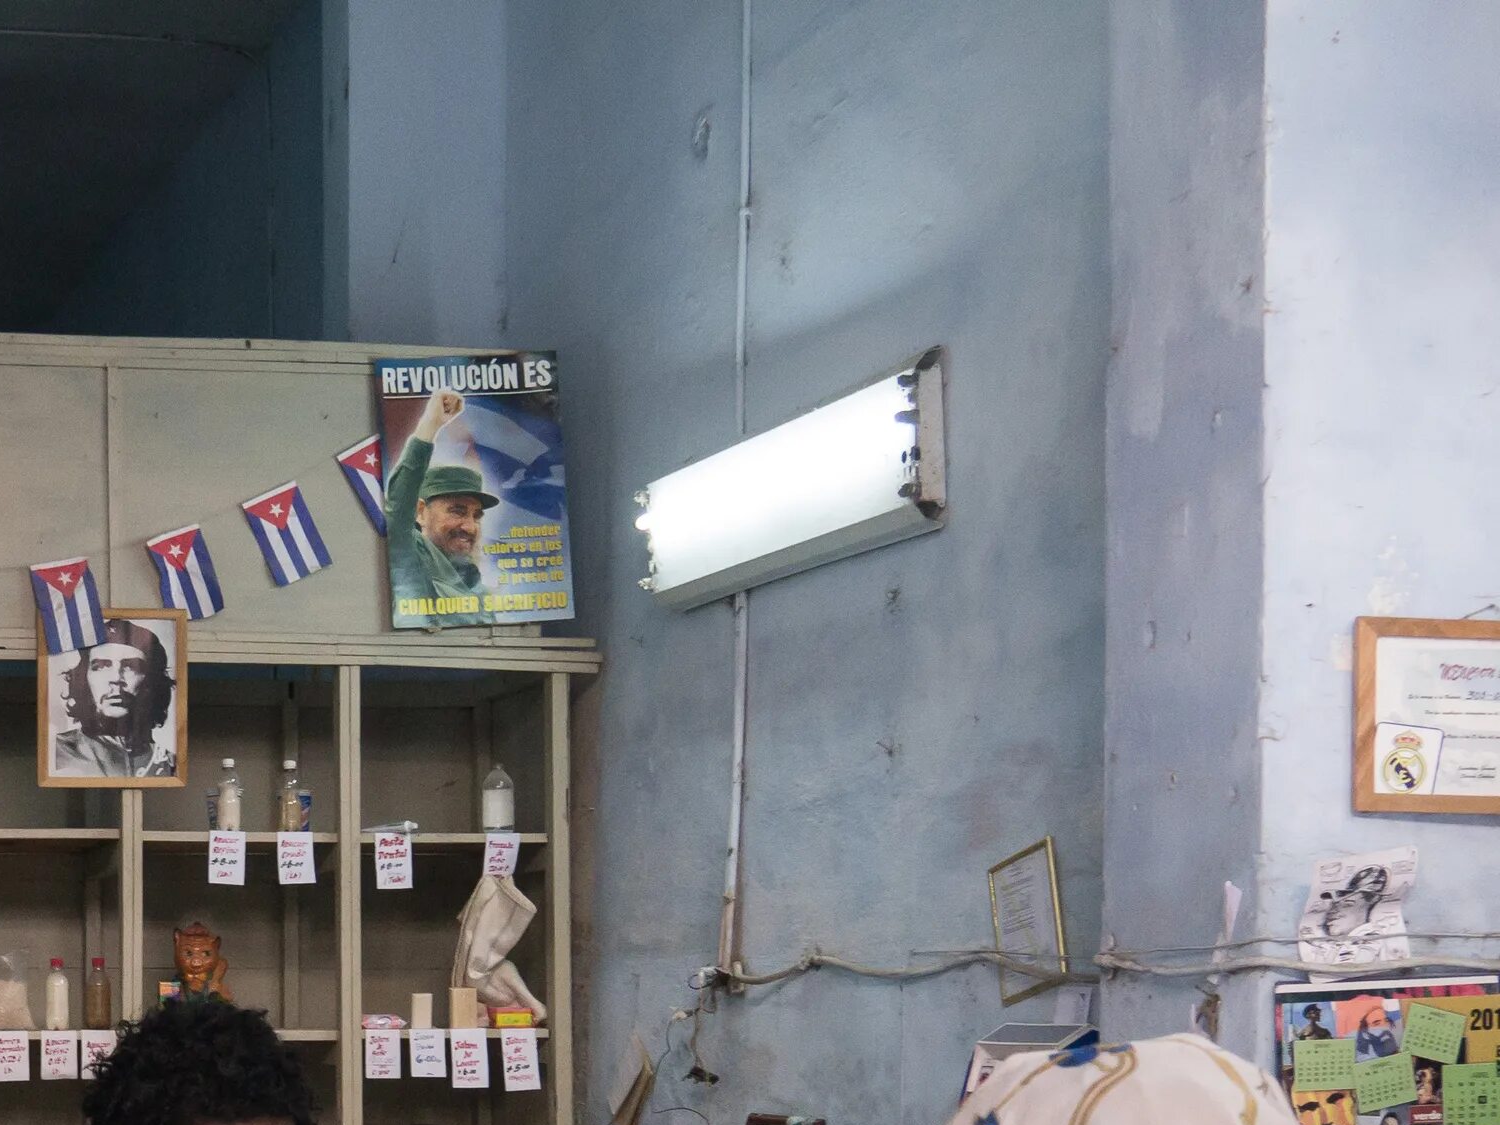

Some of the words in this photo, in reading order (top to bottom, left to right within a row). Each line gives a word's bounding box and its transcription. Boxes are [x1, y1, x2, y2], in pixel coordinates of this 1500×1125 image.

[381, 358, 519, 394] REVOLUCIÓN
[522, 359, 552, 389] ES
[399, 596, 480, 616] CUALQUIER
[483, 591, 568, 613] SACRIFICIO
